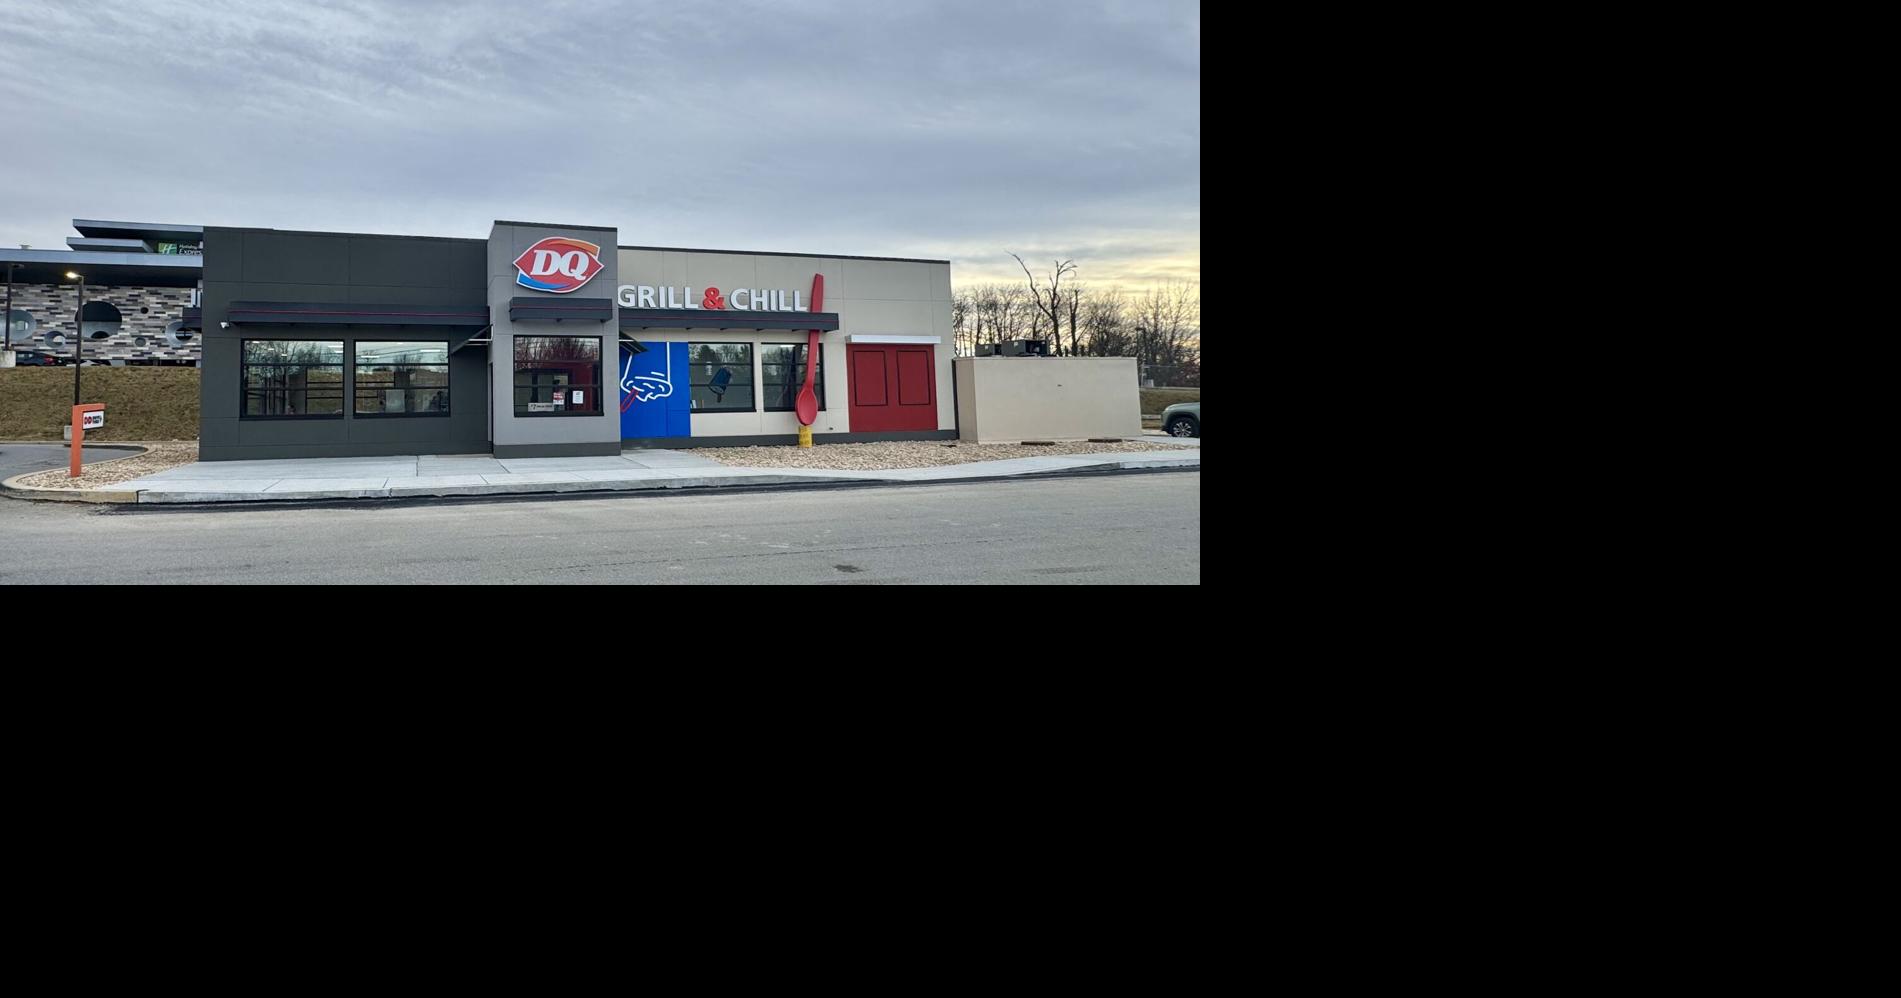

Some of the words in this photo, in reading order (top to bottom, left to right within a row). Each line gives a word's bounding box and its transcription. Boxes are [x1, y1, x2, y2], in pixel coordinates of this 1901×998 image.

[530, 249, 587, 280] DQ
[617, 284, 699, 309] GRILL
[702, 287, 725, 310] &
[729, 288, 807, 312] CHILL
